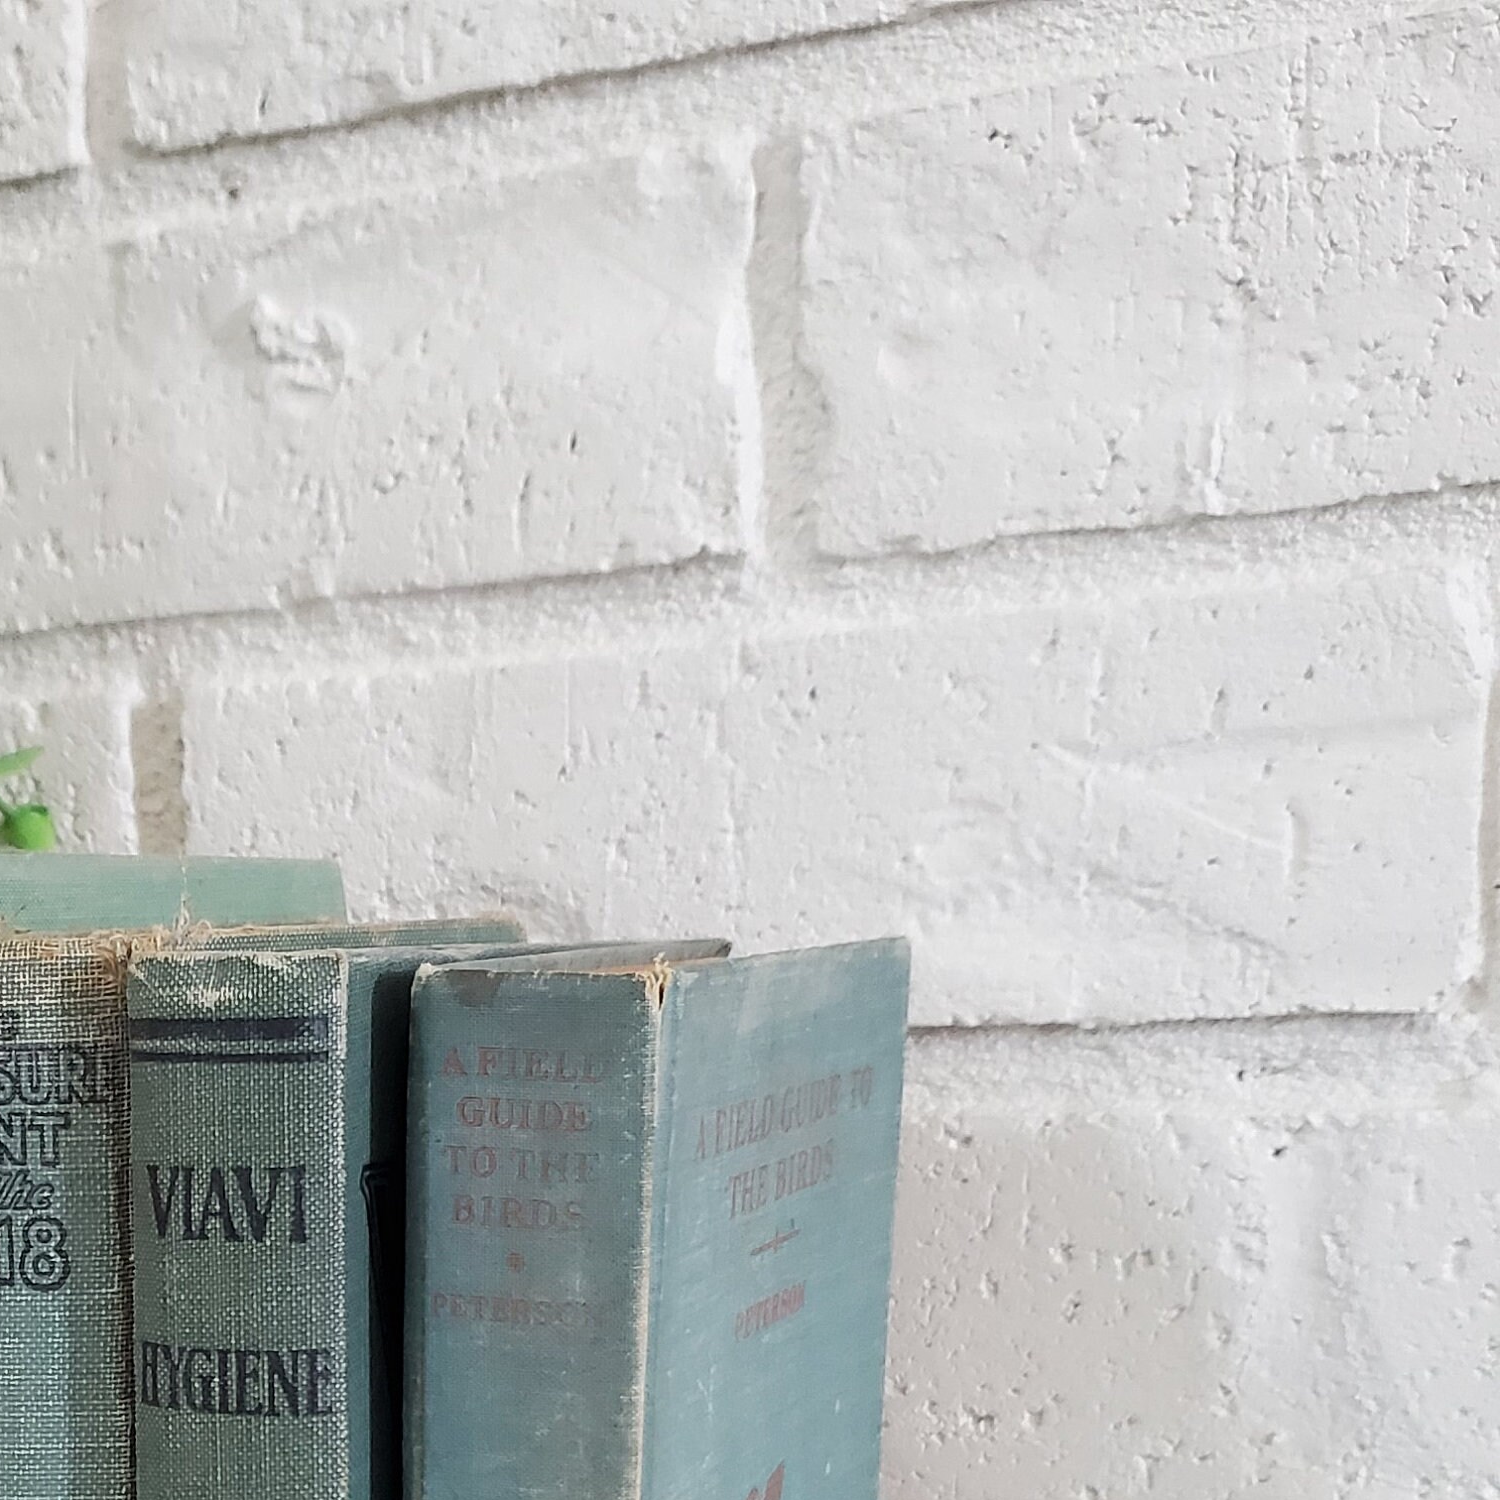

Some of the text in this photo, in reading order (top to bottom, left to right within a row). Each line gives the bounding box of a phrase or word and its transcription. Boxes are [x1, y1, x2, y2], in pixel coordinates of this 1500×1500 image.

[441, 1046, 469, 1078] A
[456, 1096, 594, 1132] GUIDE
[695, 1065, 874, 1163] A FIELD GUIDE TO
[444, 1144, 600, 1186] TO THE
[727, 1137, 834, 1220] THE BIRDS
[146, 1164, 308, 1244] VIAVI
[451, 1194, 588, 1231] BIRDS
[141, 1341, 337, 1417] HYGIENE
